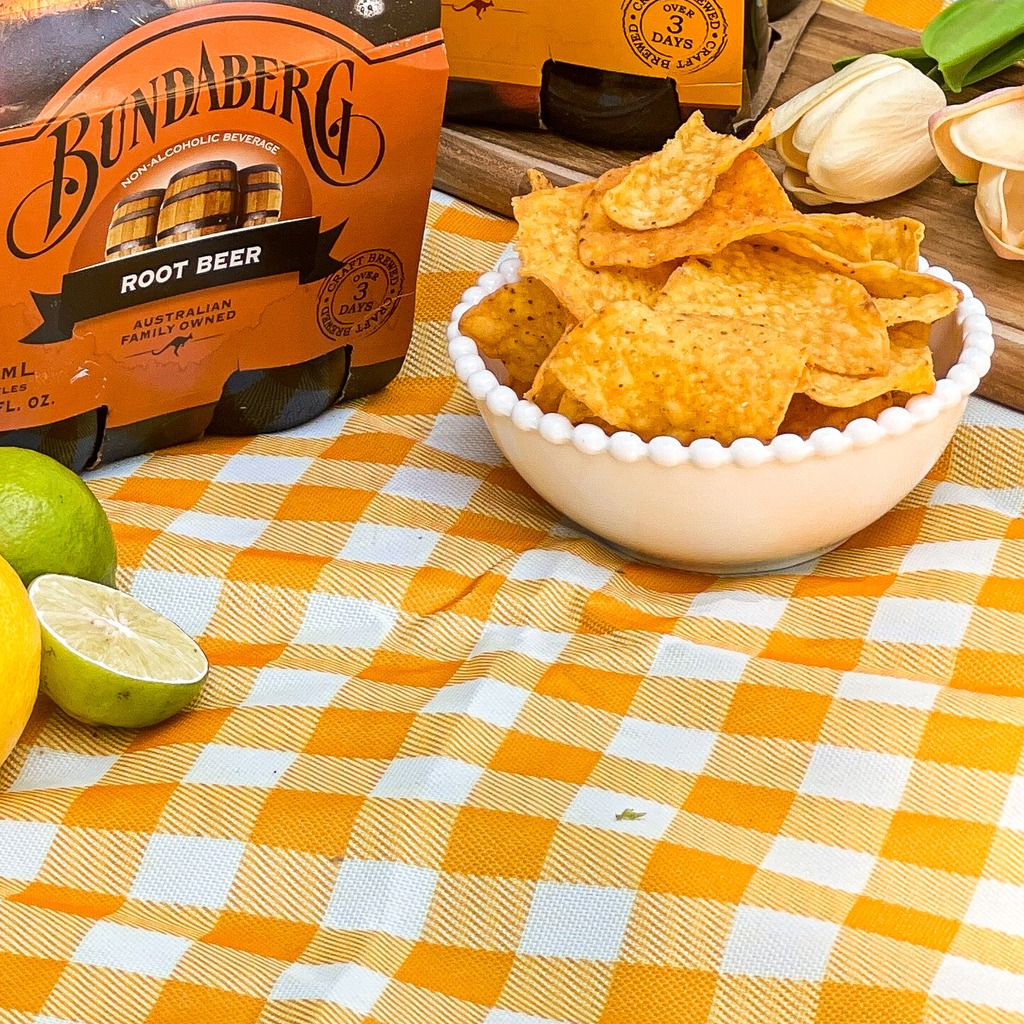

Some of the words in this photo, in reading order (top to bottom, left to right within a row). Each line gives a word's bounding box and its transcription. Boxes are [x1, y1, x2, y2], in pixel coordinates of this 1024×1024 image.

[663, 3, 695, 18] OVER
[666, 14, 684, 34] 3
[628, 23, 672, 70] BREWED
[651, 31, 693, 50] DAYS
[676, 40, 717, 69] CRAFT
[7, 40, 386, 259] BUNDABERG
[120, 133, 220, 189] NON-ALCOHOLIC
[222, 132, 281, 156] BEVERAGE
[120, 260, 190, 294] ROOT
[196, 246, 262, 275] BEER
[327, 255, 365, 293] CRAFT
[367, 253, 399, 286] BREWED
[352, 270, 380, 283] OVER
[353, 281, 369, 301] 3
[133, 298, 232, 331] AUSTRALIAN
[321, 306, 353, 337] BREWED
[338, 301, 374, 316] DAYS
[355, 297, 393, 333] CRAFT
[120, 323, 175, 346] FAMILY
[179, 310, 237, 331] OWNED
[28, 394, 55, 409] OZ.
